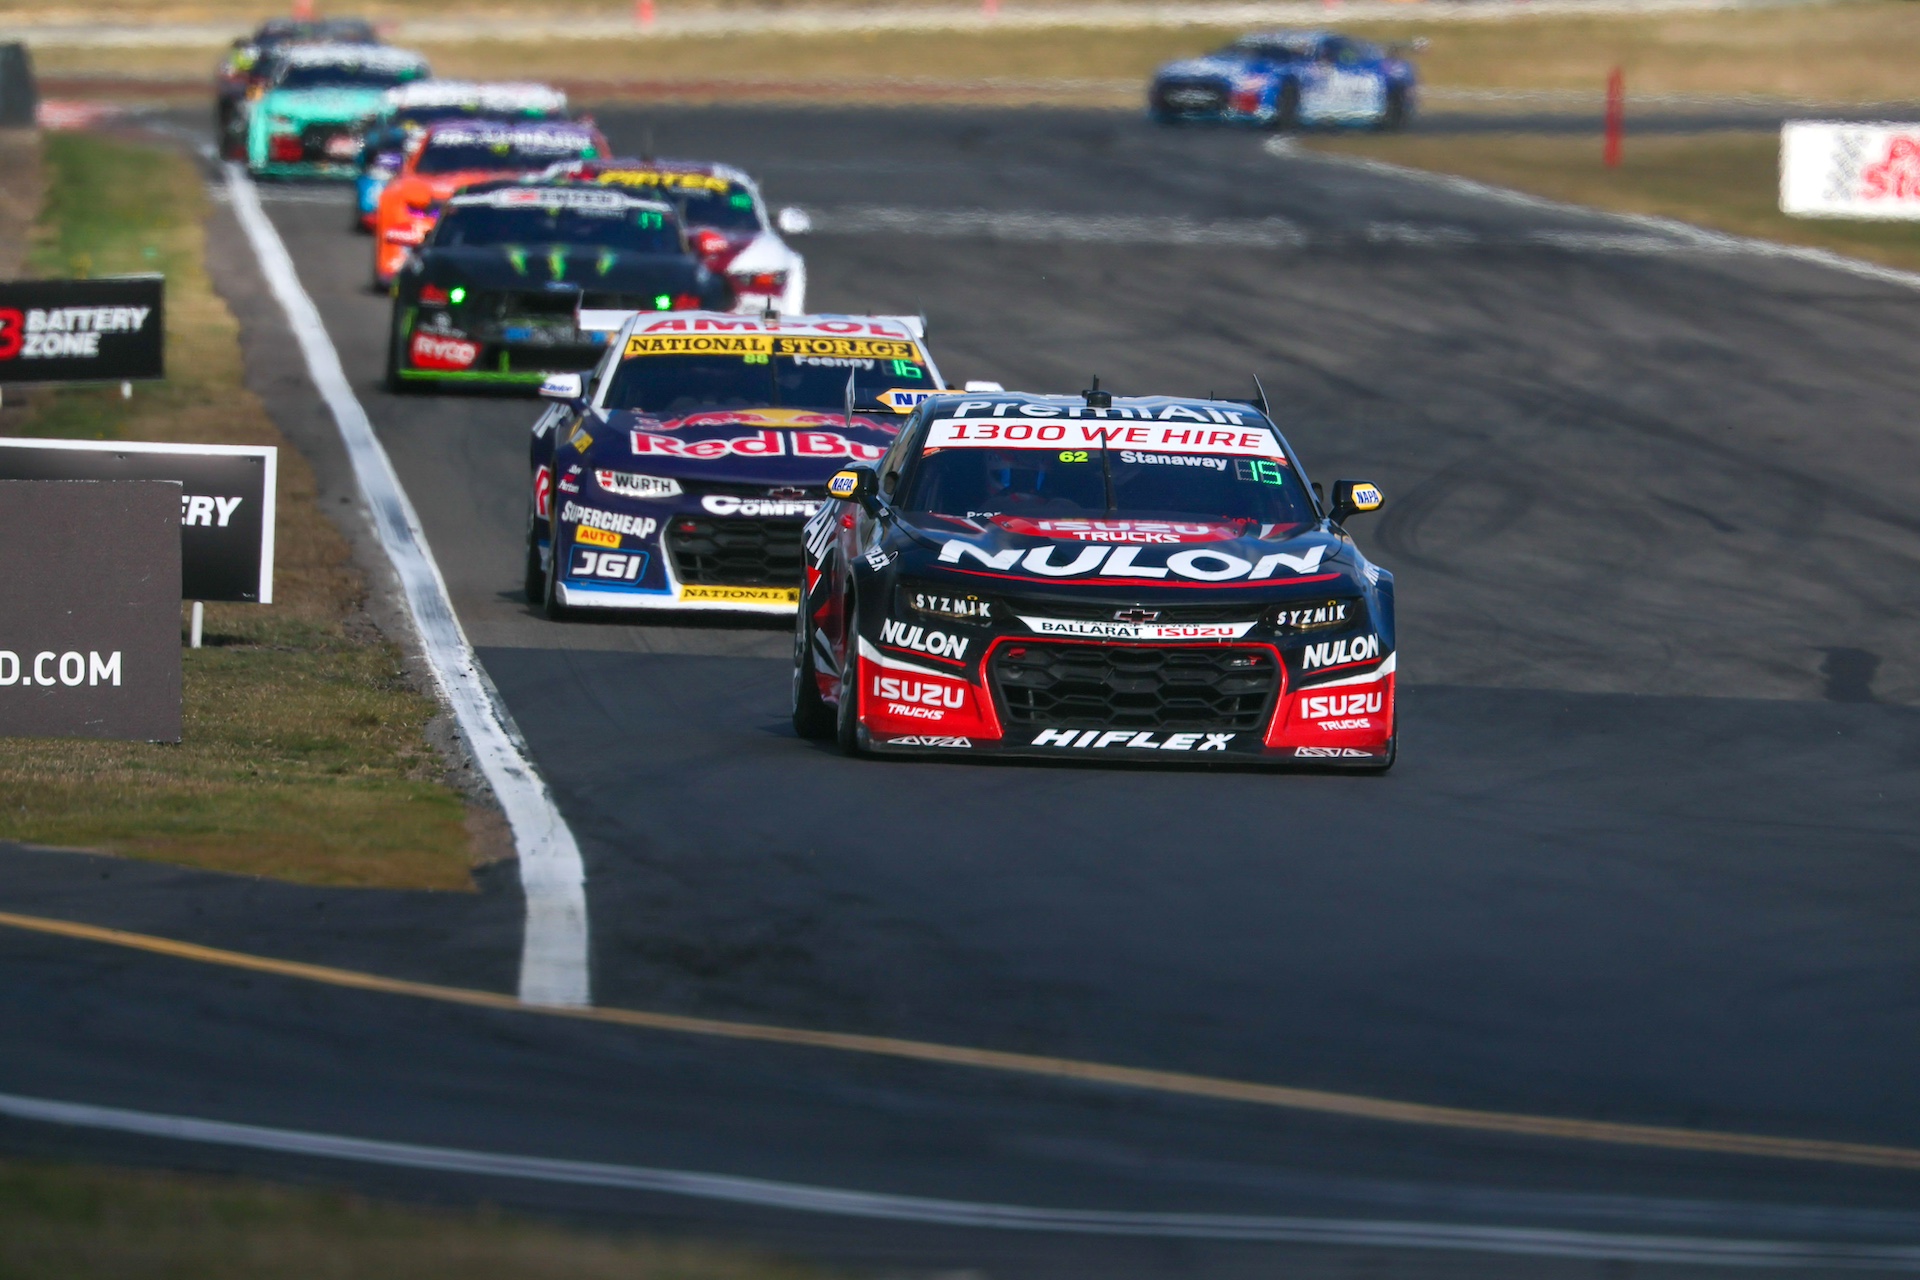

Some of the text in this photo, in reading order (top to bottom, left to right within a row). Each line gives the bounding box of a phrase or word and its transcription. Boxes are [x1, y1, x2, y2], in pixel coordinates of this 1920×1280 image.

[25, 306, 150, 332] BATTERY
[23, 331, 100, 358] ZONE
[631, 337, 910, 356] NATIONAL STORAGE
[743, 354, 769, 365] 88
[793, 354, 876, 370] Feeney
[891, 359, 923, 379] 16
[953, 401, 1243, 425] PremiAir
[630, 430, 888, 461] Red Bu
[948, 424, 1263, 449] 1300 WE HIRE
[1059, 451, 1089, 463] 62
[1120, 450, 1228, 472] Stanaway
[615, 474, 672, 493] WÜRTH
[832, 477, 855, 491] NAPA
[1356, 490, 1380, 504] NAPA
[561, 500, 657, 540] SUPERCHEAP
[1038, 521, 1210, 535] ISUZU
[580, 529, 617, 544] AUTO
[1072, 531, 1181, 544] TRUCKS
[571, 551, 642, 580] JGI
[937, 539, 1328, 582] NULON
[683, 589, 784, 600] NATIONAL
[880, 617, 970, 661] NULON
[1041, 622, 1234, 637] BALLARAT ISUZU
[1302, 633, 1380, 670] NULON
[873, 675, 965, 709] ISUZU
[888, 703, 944, 721] TRUCKS
[1301, 691, 1382, 719] ISUZU
[1317, 718, 1371, 731] TRUCKS
[1030, 728, 1236, 752] HIFLEX
